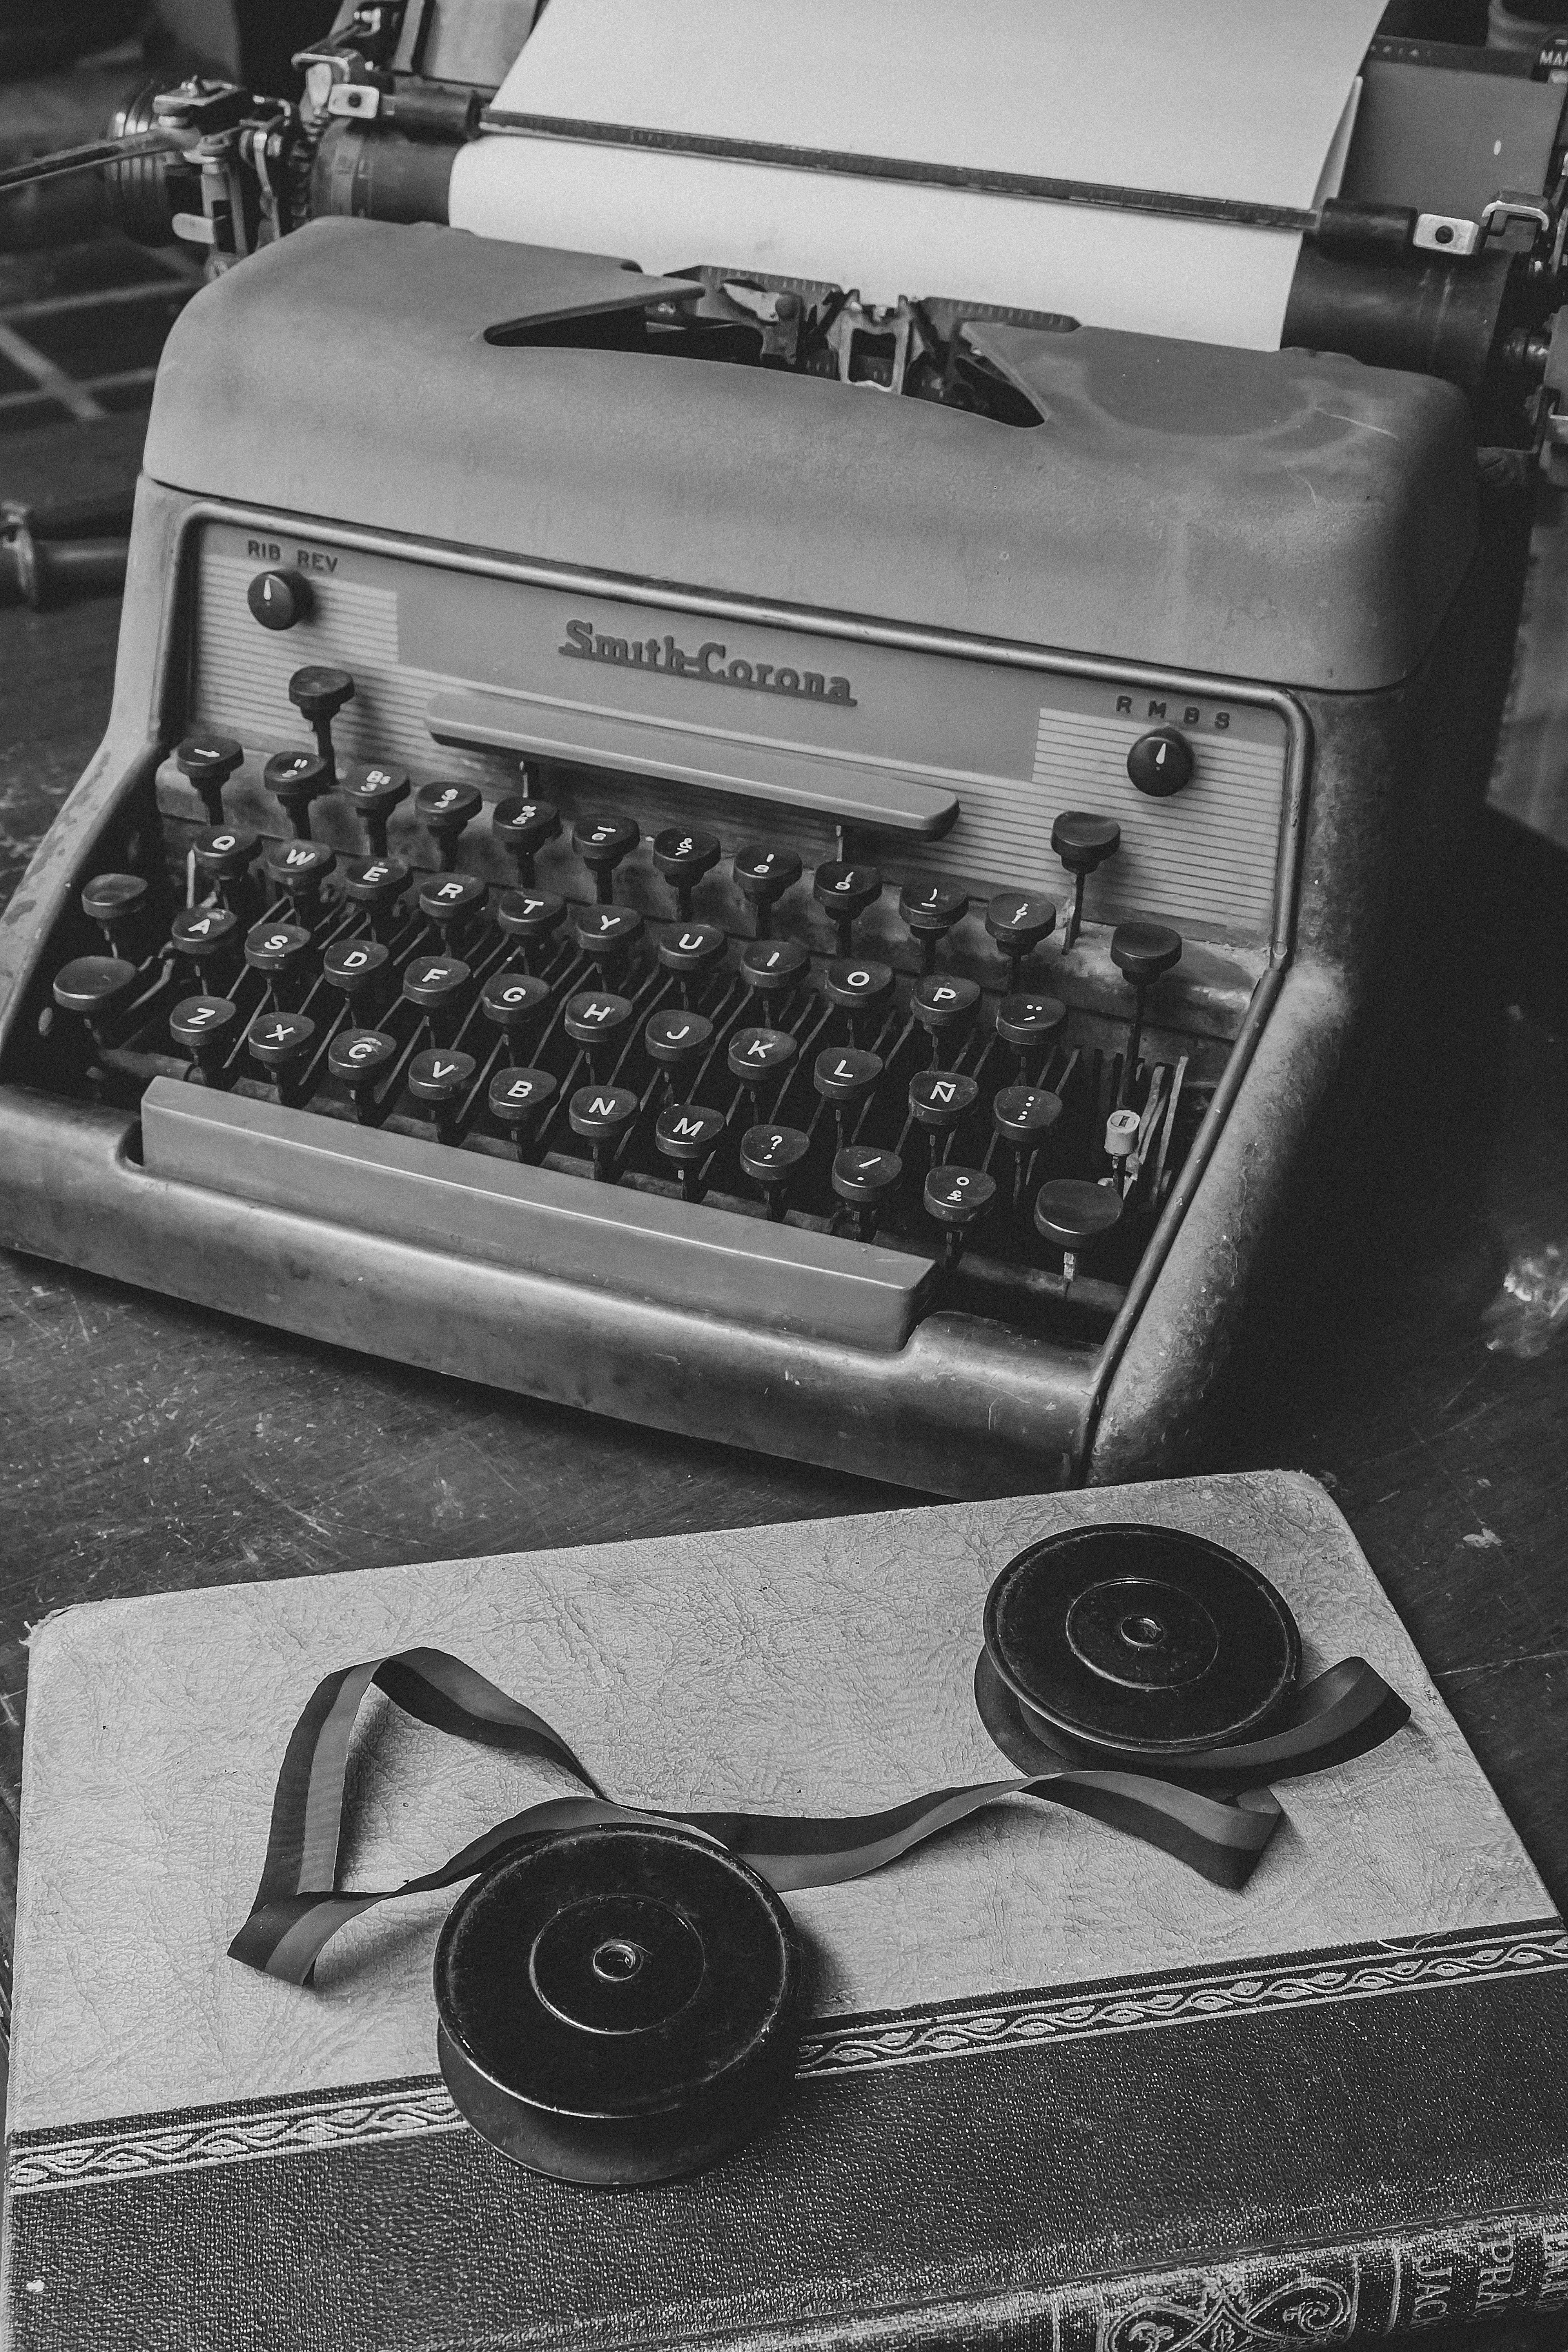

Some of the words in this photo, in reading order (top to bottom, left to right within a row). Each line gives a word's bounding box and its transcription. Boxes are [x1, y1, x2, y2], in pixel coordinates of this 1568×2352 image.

[247, 539, 281, 561] RIB
[297, 550, 339, 573] REV
[558, 619, 858, 706] Smith-Corona
[1116, 695, 1133, 714] R
[1148, 700, 1167, 719] M
[1183, 706, 1200, 724] B
[212, 835, 235, 850] Q
[286, 849, 315, 866] W
[363, 866, 388, 882] E
[438, 883, 463, 898] R
[523, 899, 544, 914] T
[188, 918, 210, 934] A
[600, 915, 621, 930] Y
[264, 935, 288, 949] S
[679, 933, 703, 949] U
[343, 951, 367, 967] D
[767, 952, 780, 966] I
[422, 968, 448, 982] F
[847, 971, 870, 986] O
[503, 987, 526, 1002] G
[933, 987, 956, 1002] P
[187, 1007, 216, 1025] Z
[583, 1004, 611, 1021] H
[265, 1024, 294, 1041] X
[666, 1026, 690, 1040] J
[348, 1042, 372, 1059] C
[748, 1040, 775, 1058] K
[433, 1061, 455, 1078] V
[834, 1060, 853, 1078] L
[507, 1080, 533, 1098] B
[930, 1081, 956, 1102] Ñ
[588, 1098, 615, 1115] N
[673, 1118, 704, 1136] M
[771, 1135, 782, 1147] ?
